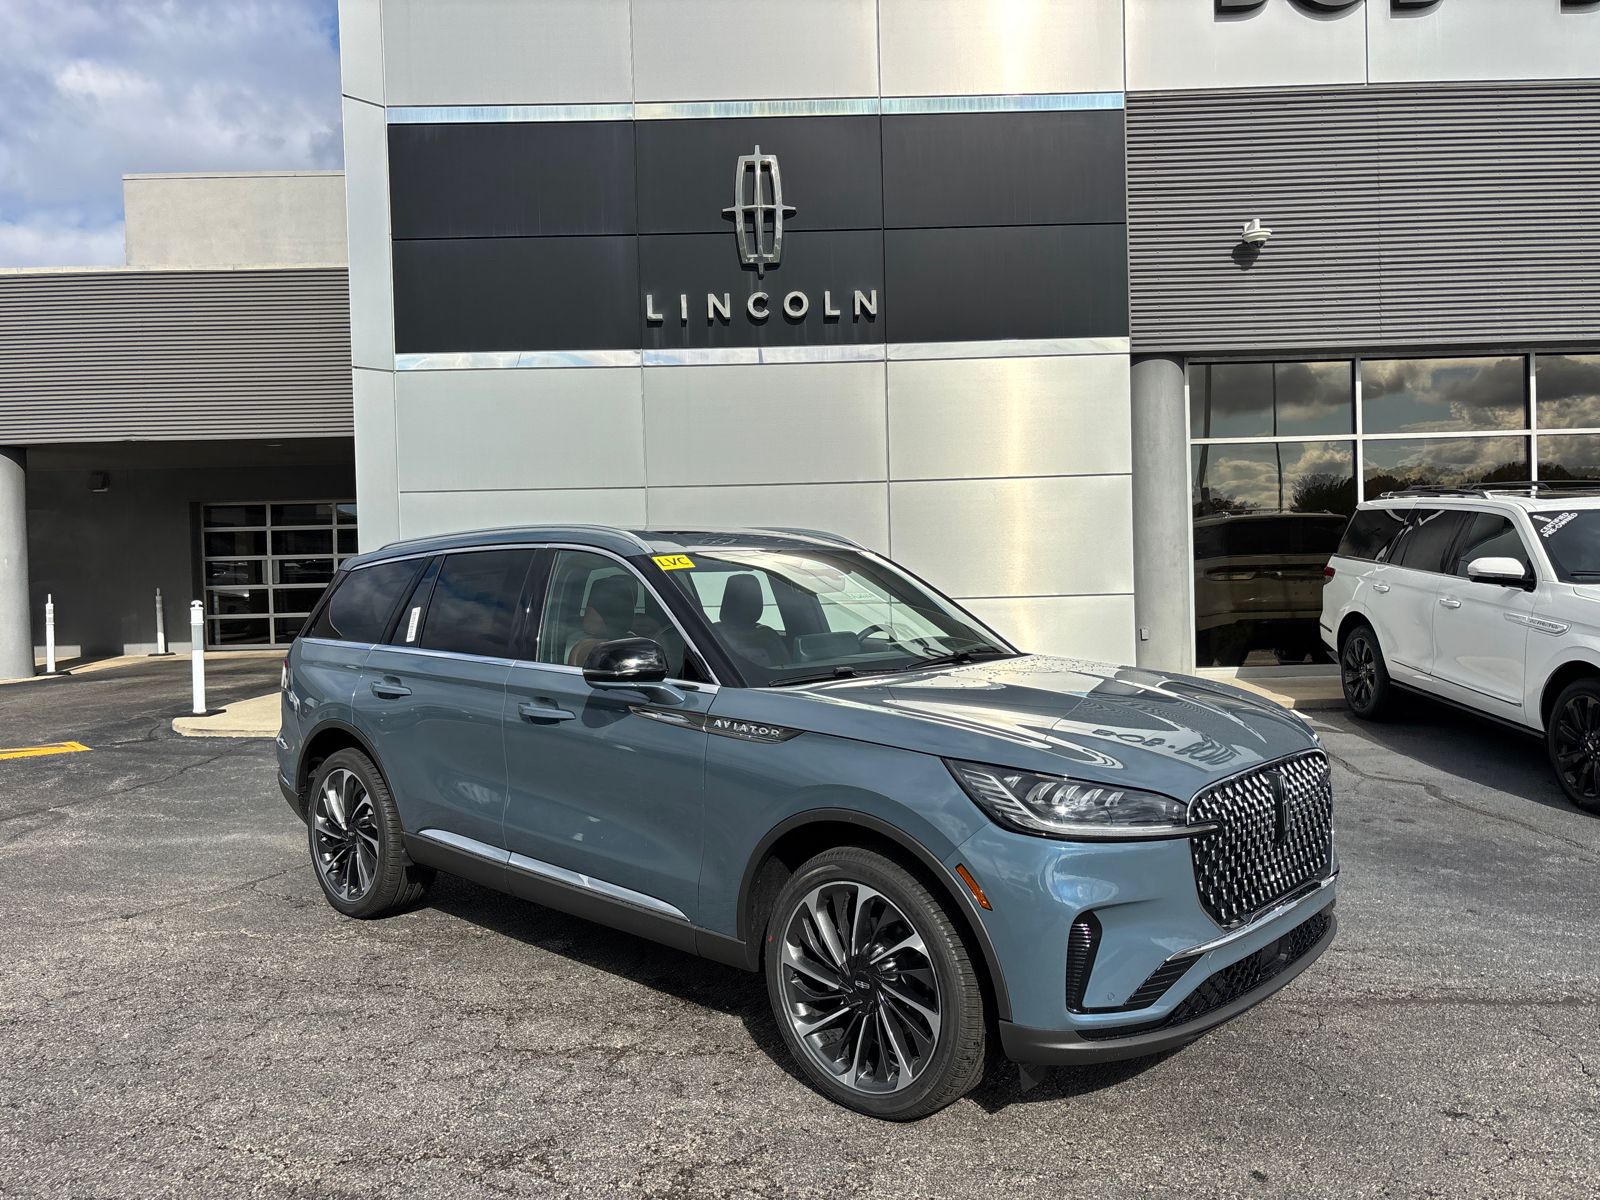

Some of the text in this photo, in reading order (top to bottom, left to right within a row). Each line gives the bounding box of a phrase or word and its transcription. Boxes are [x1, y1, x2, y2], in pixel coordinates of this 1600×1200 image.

[646, 290, 878, 322] LINCOLN
[656, 557, 690, 567] LVC
[713, 719, 780, 738] AVIATOR
